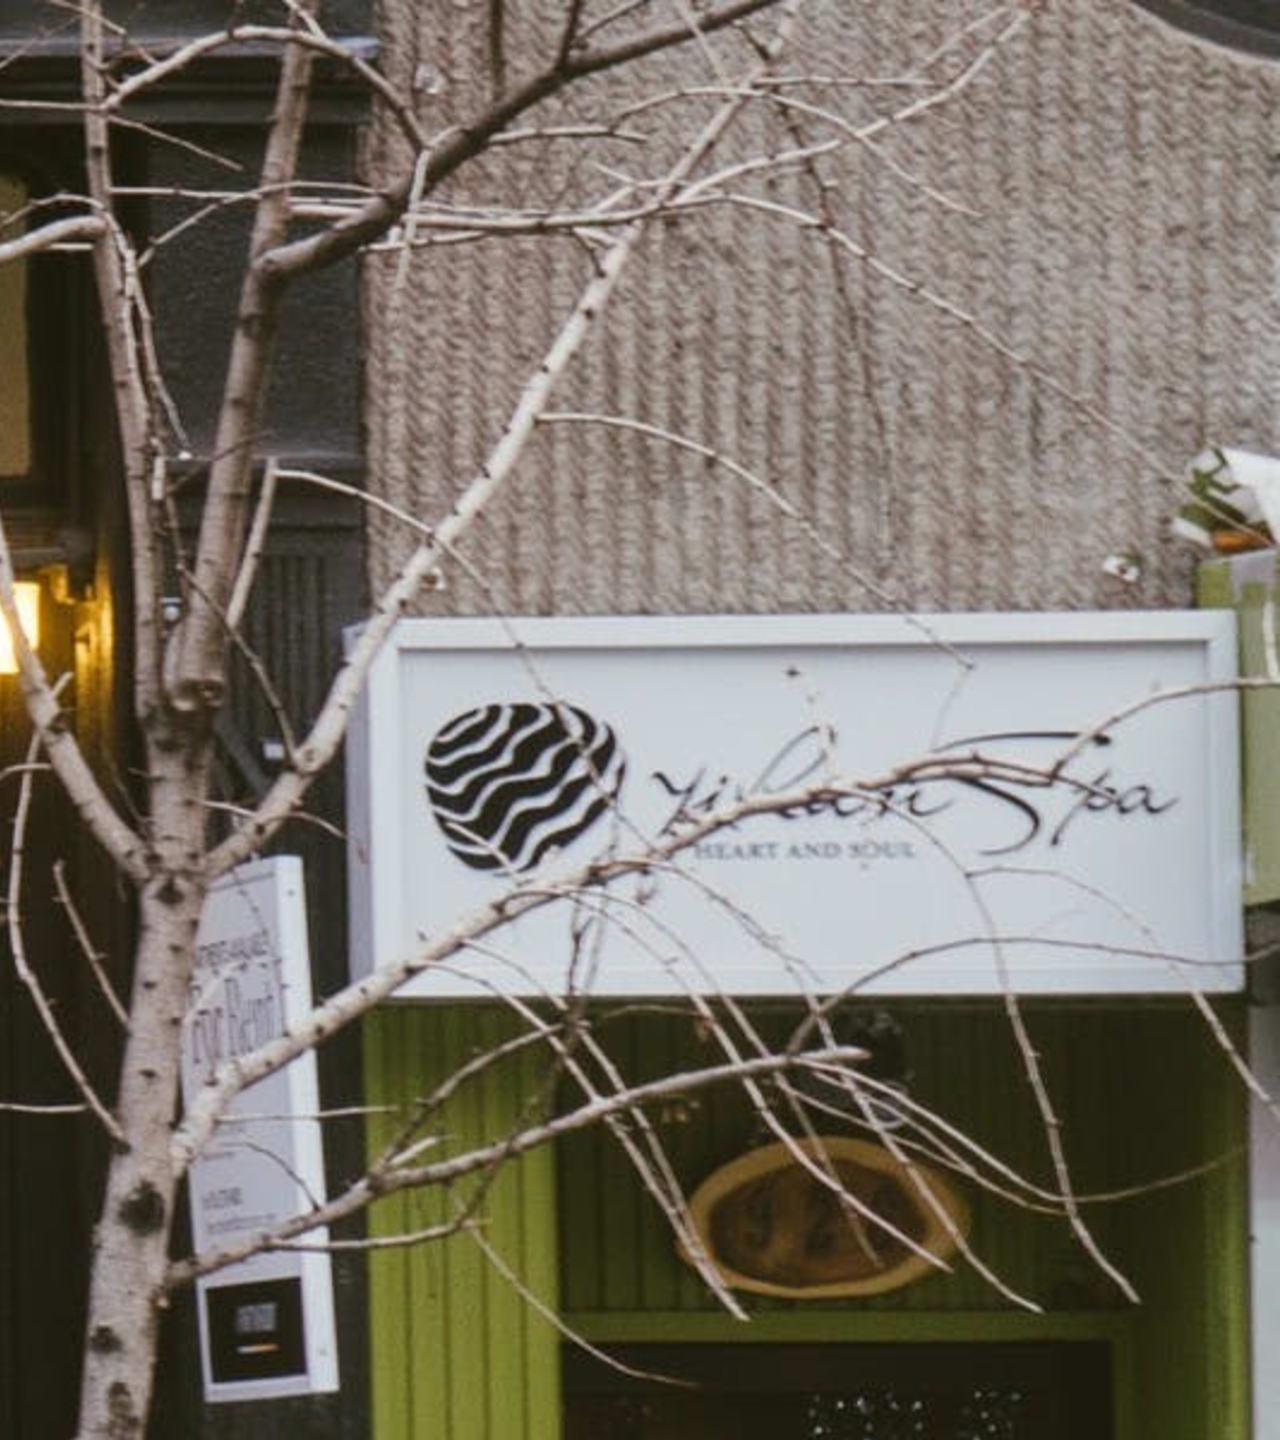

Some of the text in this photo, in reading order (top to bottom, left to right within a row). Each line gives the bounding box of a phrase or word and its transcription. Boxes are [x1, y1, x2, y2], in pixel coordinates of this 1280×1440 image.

[694, 841, 916, 860] HEART AND SOUL
